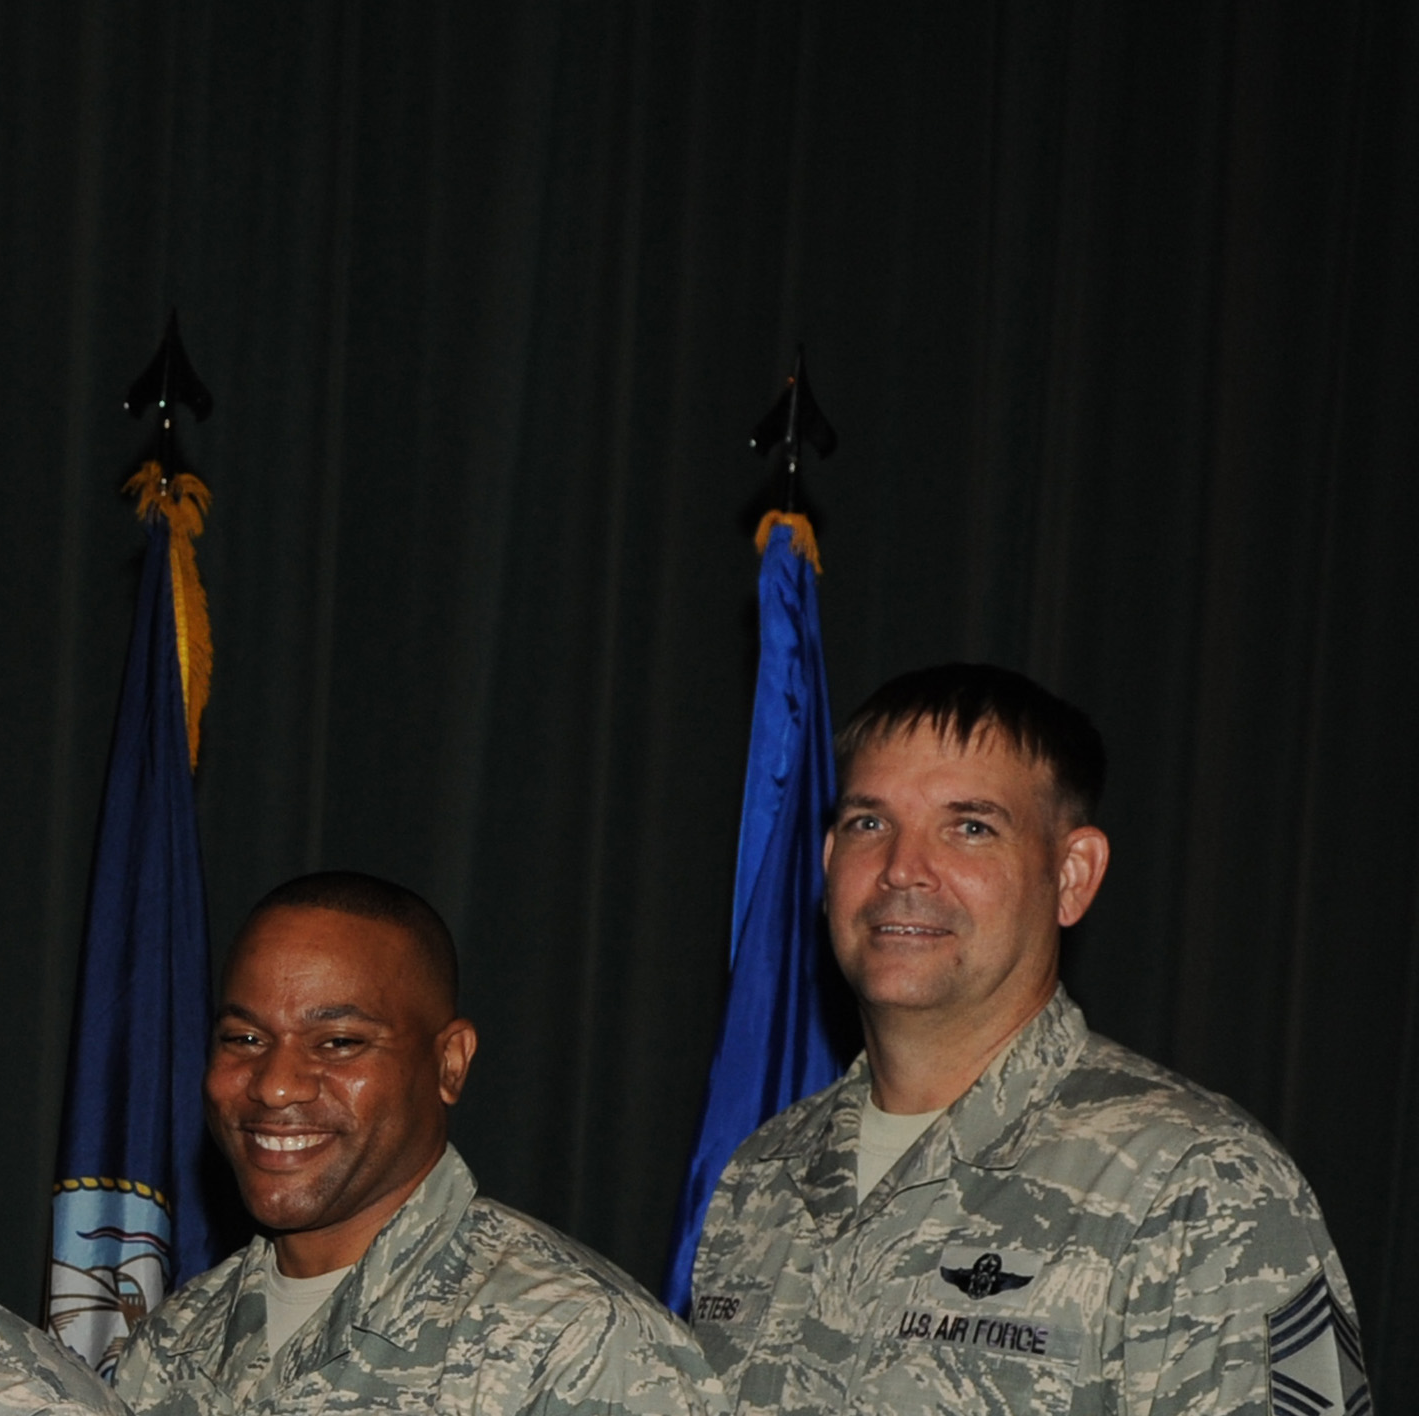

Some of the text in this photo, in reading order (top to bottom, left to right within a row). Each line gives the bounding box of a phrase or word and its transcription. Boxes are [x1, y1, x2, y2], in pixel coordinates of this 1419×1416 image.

[698, 1295, 740, 1320] PETERS
[899, 1311, 1049, 1355] U.S. AIR FORCE
